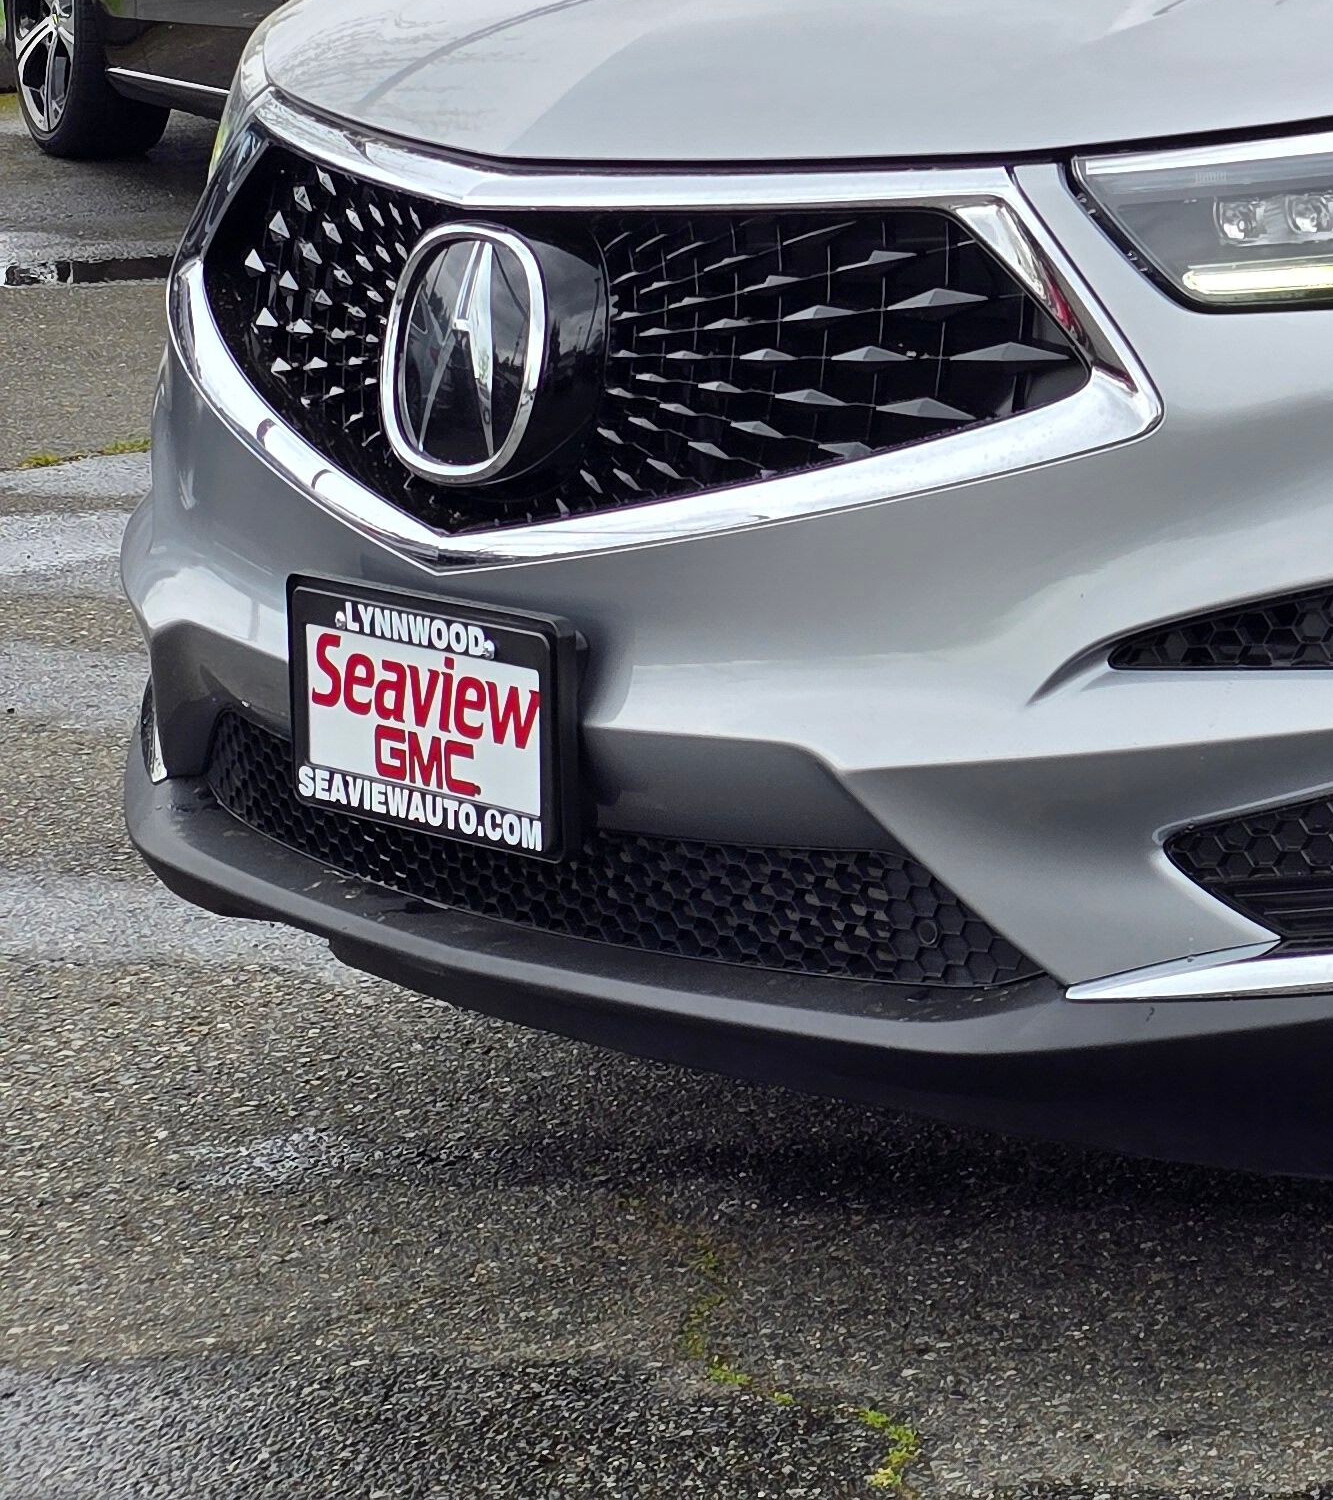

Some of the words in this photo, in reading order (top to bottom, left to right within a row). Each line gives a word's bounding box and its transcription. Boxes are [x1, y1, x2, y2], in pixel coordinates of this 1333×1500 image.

[344, 601, 485, 656] LYNNWOOD
[311, 632, 541, 750] Seaview
[374, 724, 482, 798] GMC
[298, 765, 543, 852] SEAVIEWAUTO.COM
